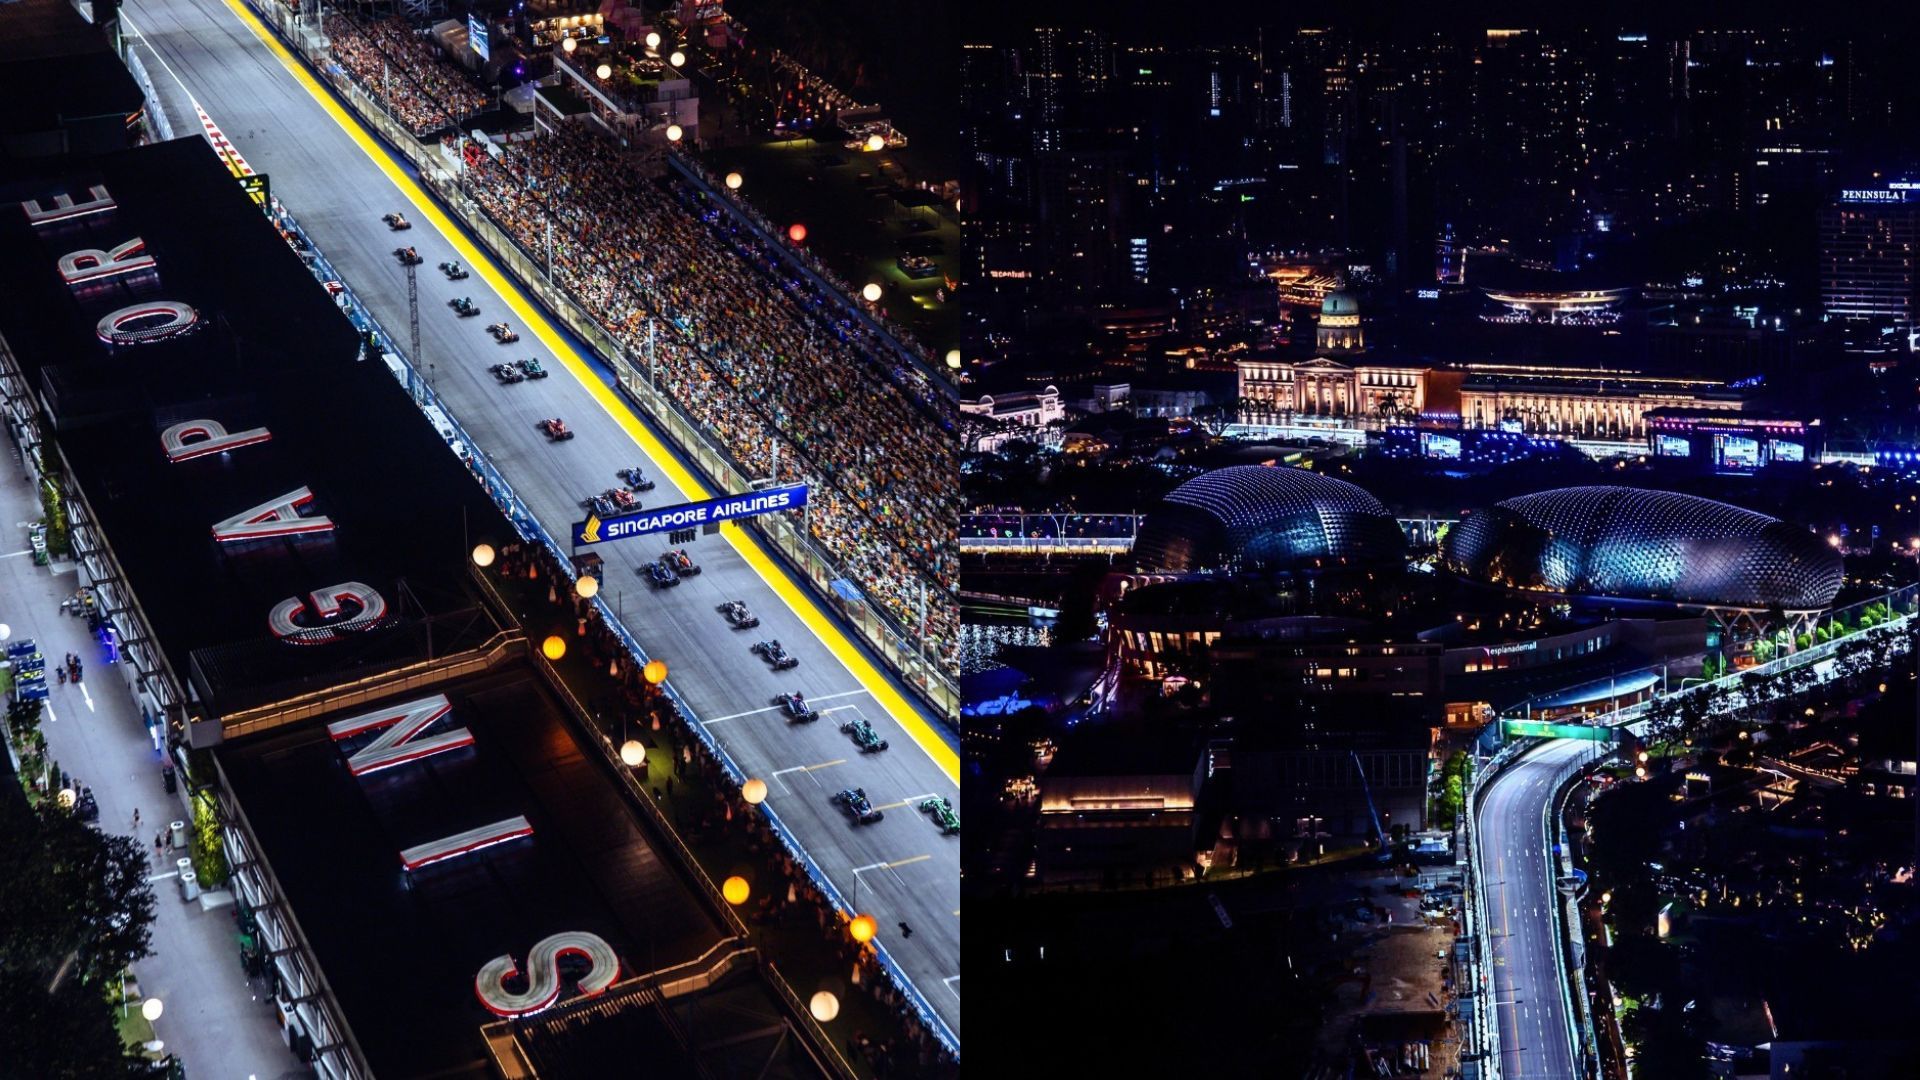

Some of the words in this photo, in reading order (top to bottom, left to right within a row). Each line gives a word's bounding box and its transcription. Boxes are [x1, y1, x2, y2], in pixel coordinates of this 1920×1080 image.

[1842, 190, 1899, 199] PENINSULA
[607, 508, 707, 537] SINGAPORE
[712, 493, 790, 518] AIRLINES
[22, 183, 622, 1019] SINGAPORE
[1490, 641, 1537, 656] esplanademall
